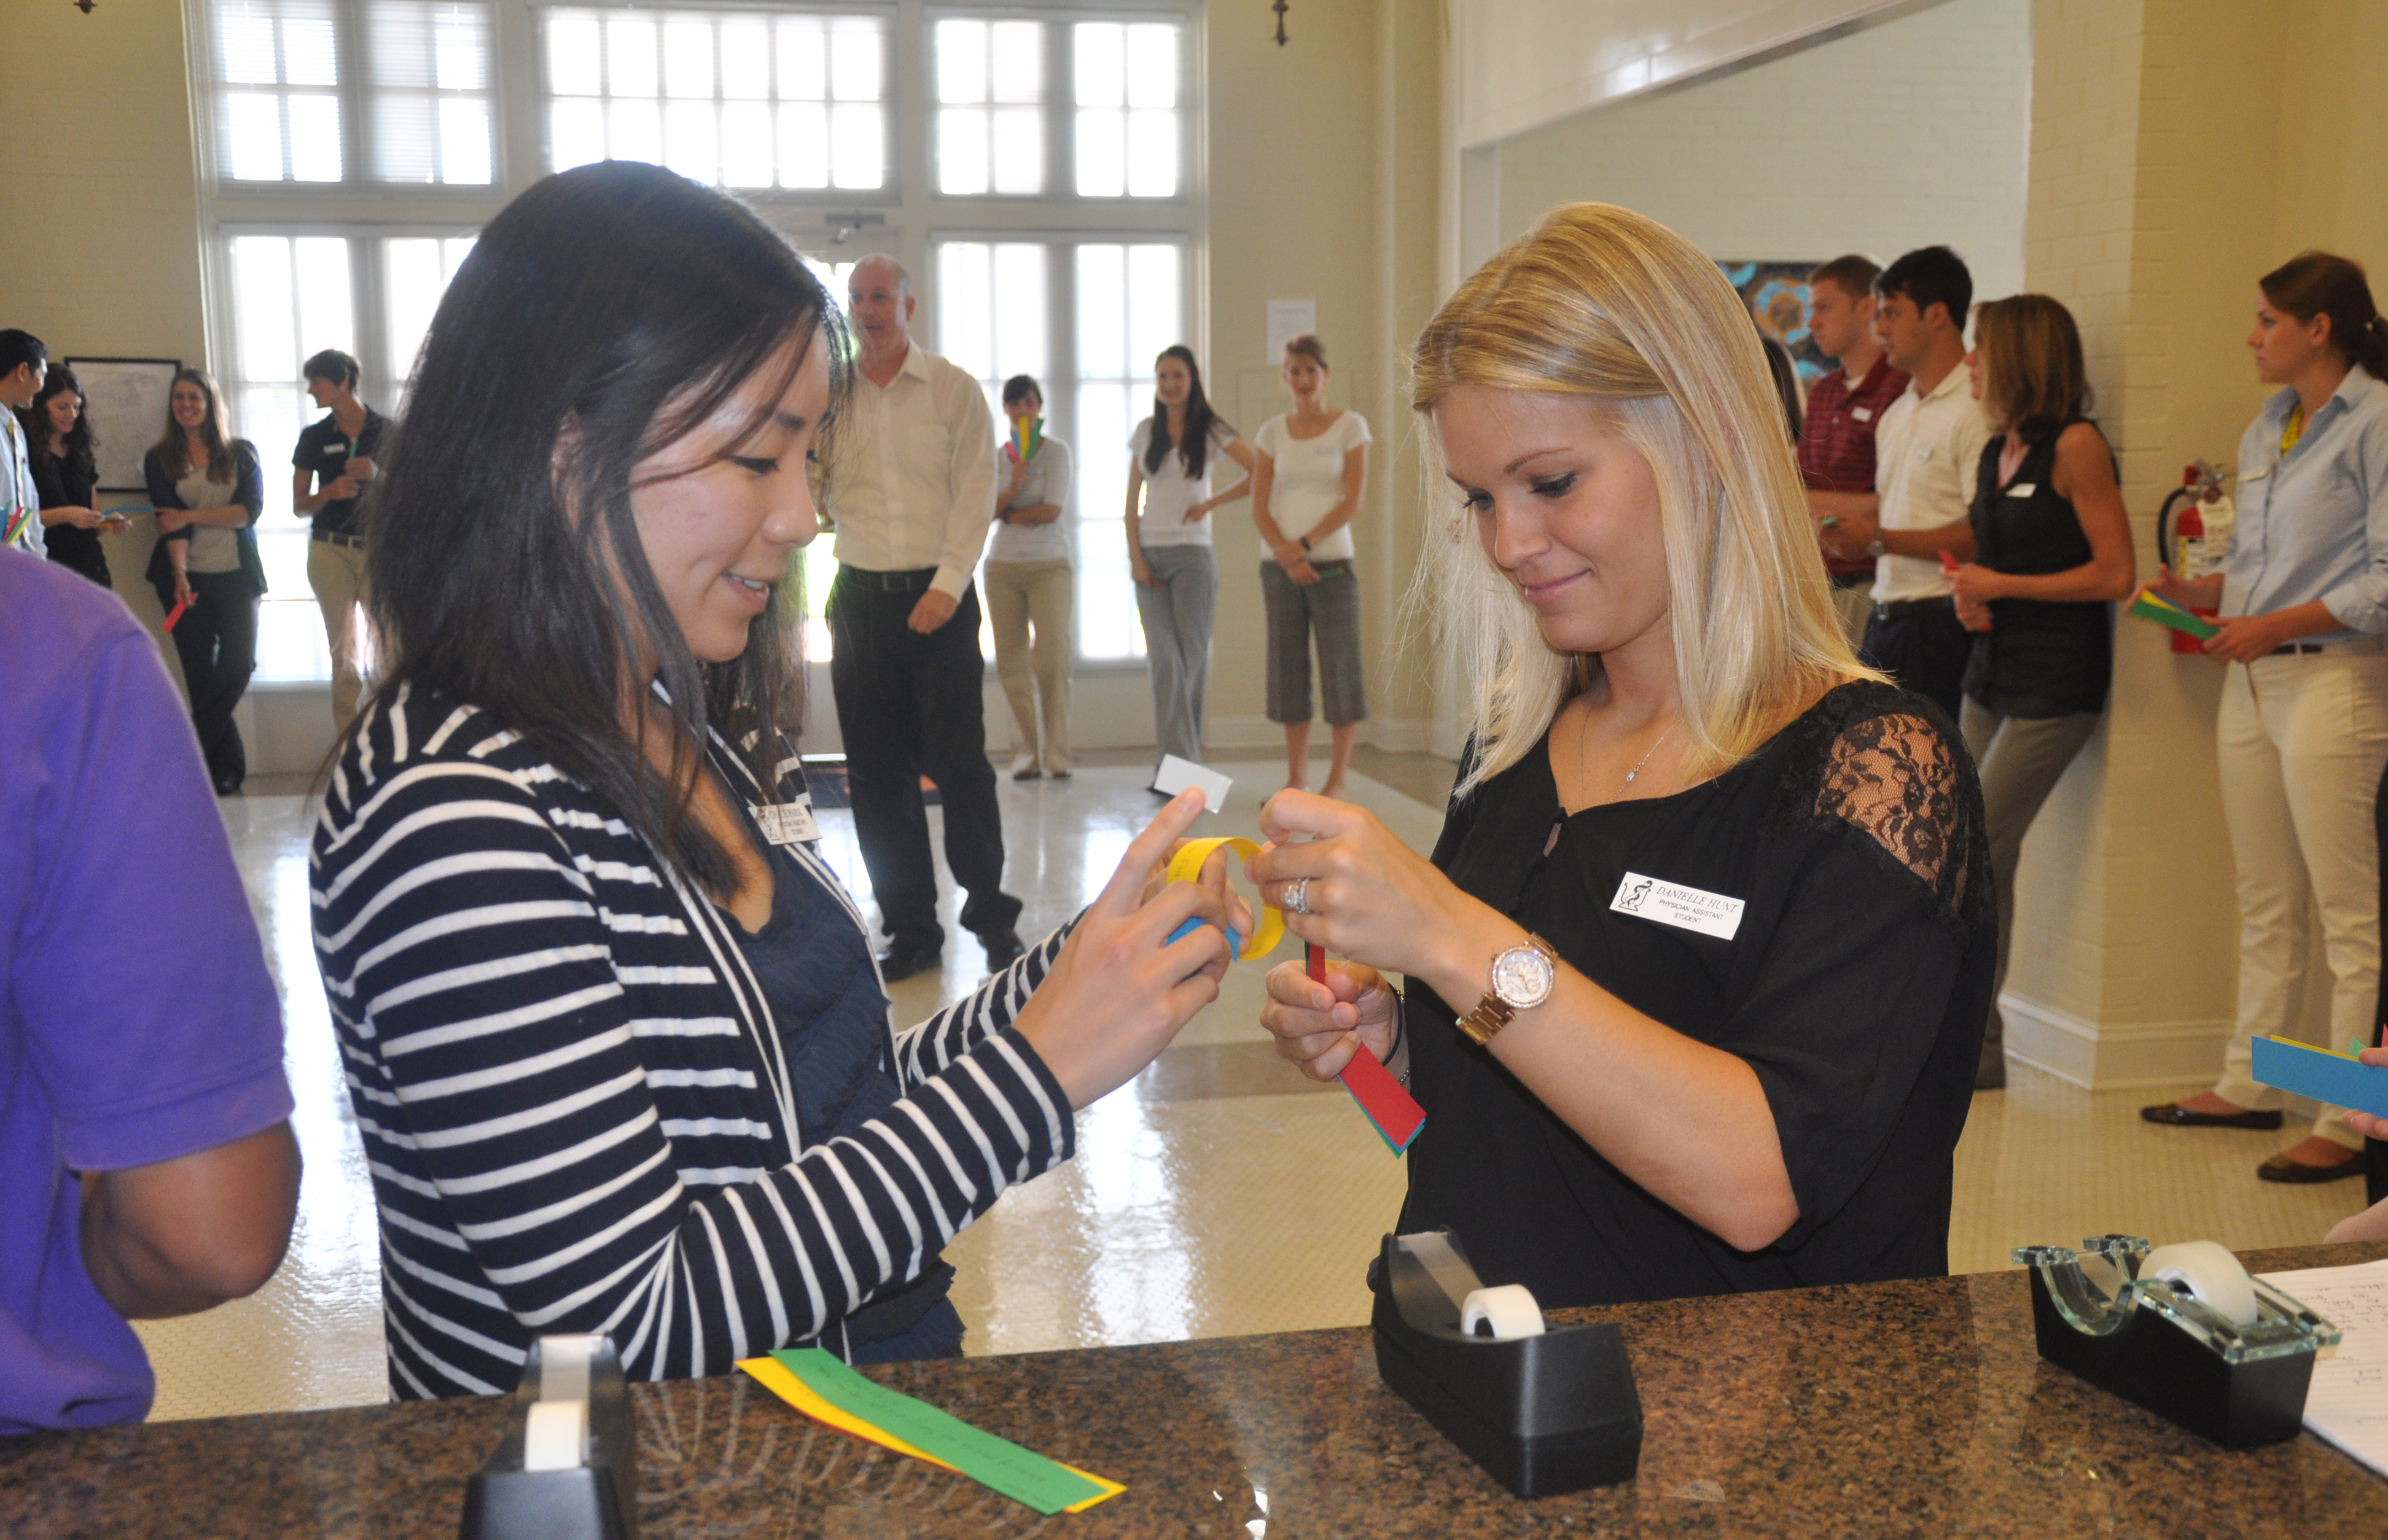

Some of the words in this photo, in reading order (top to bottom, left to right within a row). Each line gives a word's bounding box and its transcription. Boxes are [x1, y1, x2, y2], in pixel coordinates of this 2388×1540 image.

[1656, 886, 1707, 905] DANIELLE
[1707, 899, 1739, 912] HUNT
[1658, 899, 1690, 912] PHYSICIAN
[1691, 908, 1724, 920] ASSISTANT
[1674, 912, 1702, 924] STUDENT
